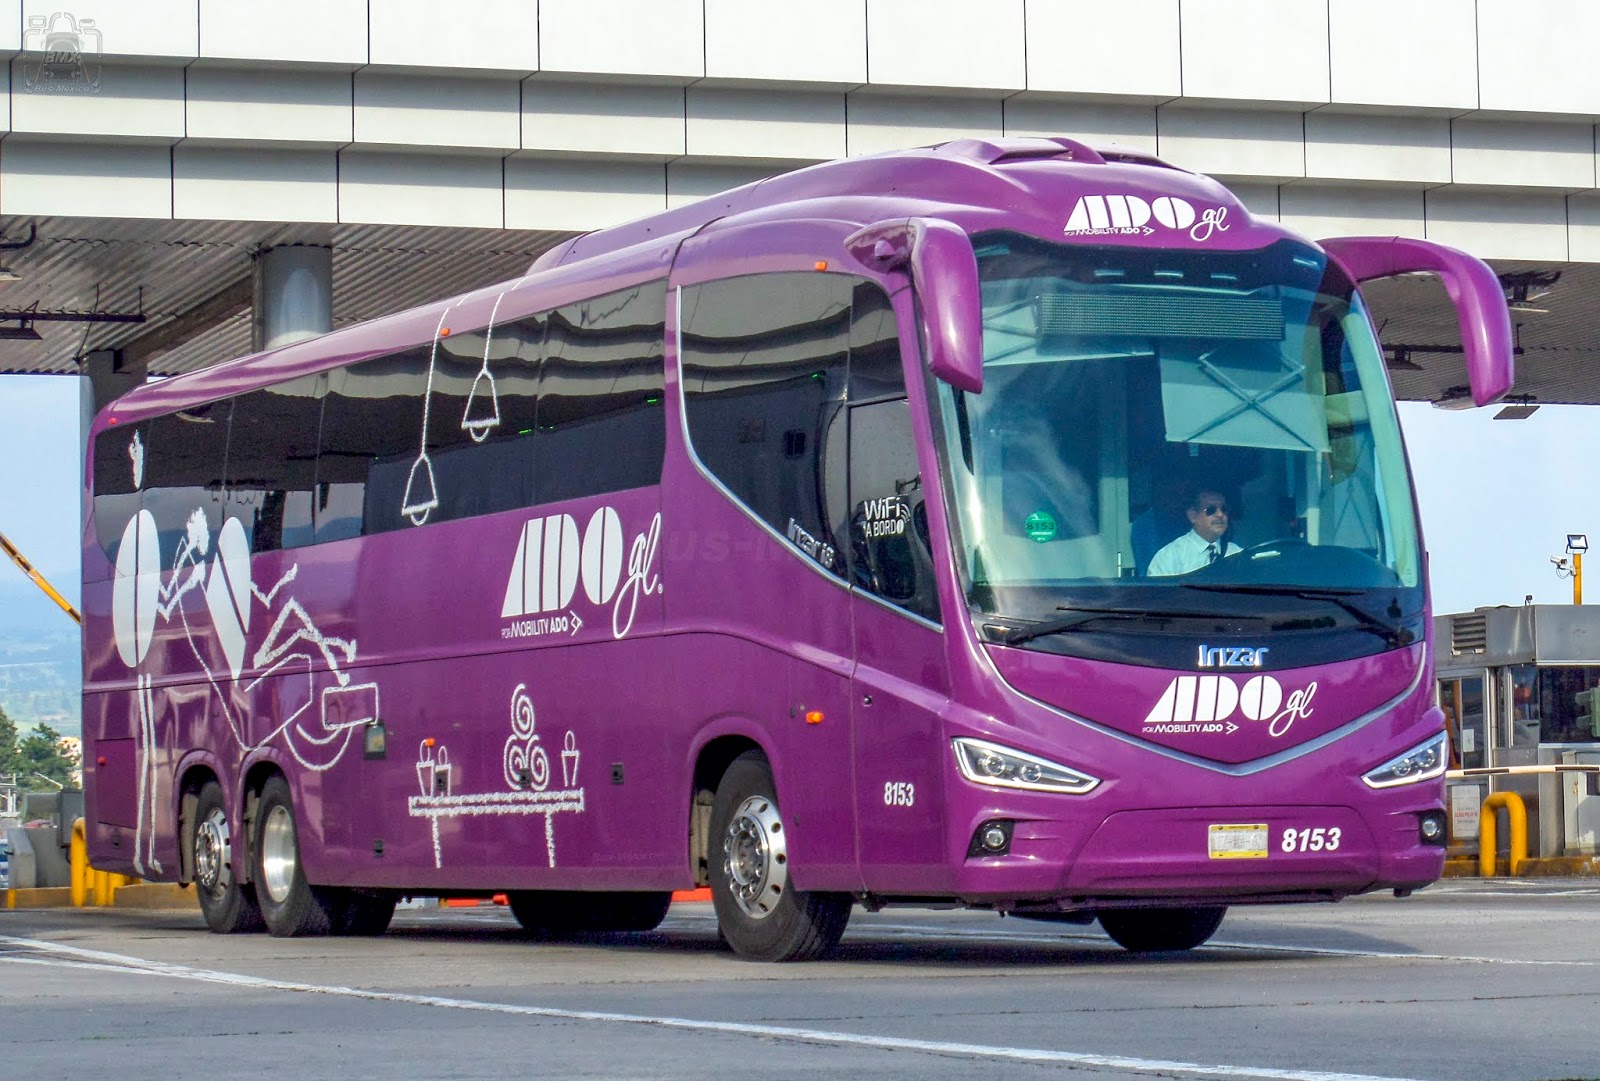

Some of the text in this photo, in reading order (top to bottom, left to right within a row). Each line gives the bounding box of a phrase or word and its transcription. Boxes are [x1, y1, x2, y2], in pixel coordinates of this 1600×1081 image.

[1063, 194, 1196, 231] ADO
[1120, 227, 1141, 235] ADO
[863, 496, 901, 521] WiFi
[1026, 522, 1055, 531] 8153
[501, 506, 623, 617] ADO
[511, 618, 549, 638] MOBILITY
[549, 616, 569, 634] ADO
[1198, 644, 1270, 666] Irizar
[1144, 675, 1283, 722] ADO
[1154, 723, 1202, 733] MOBILITY
[1201, 723, 1224, 732] ADO
[884, 781, 915, 807] 8153
[1281, 827, 1342, 853] 8153
